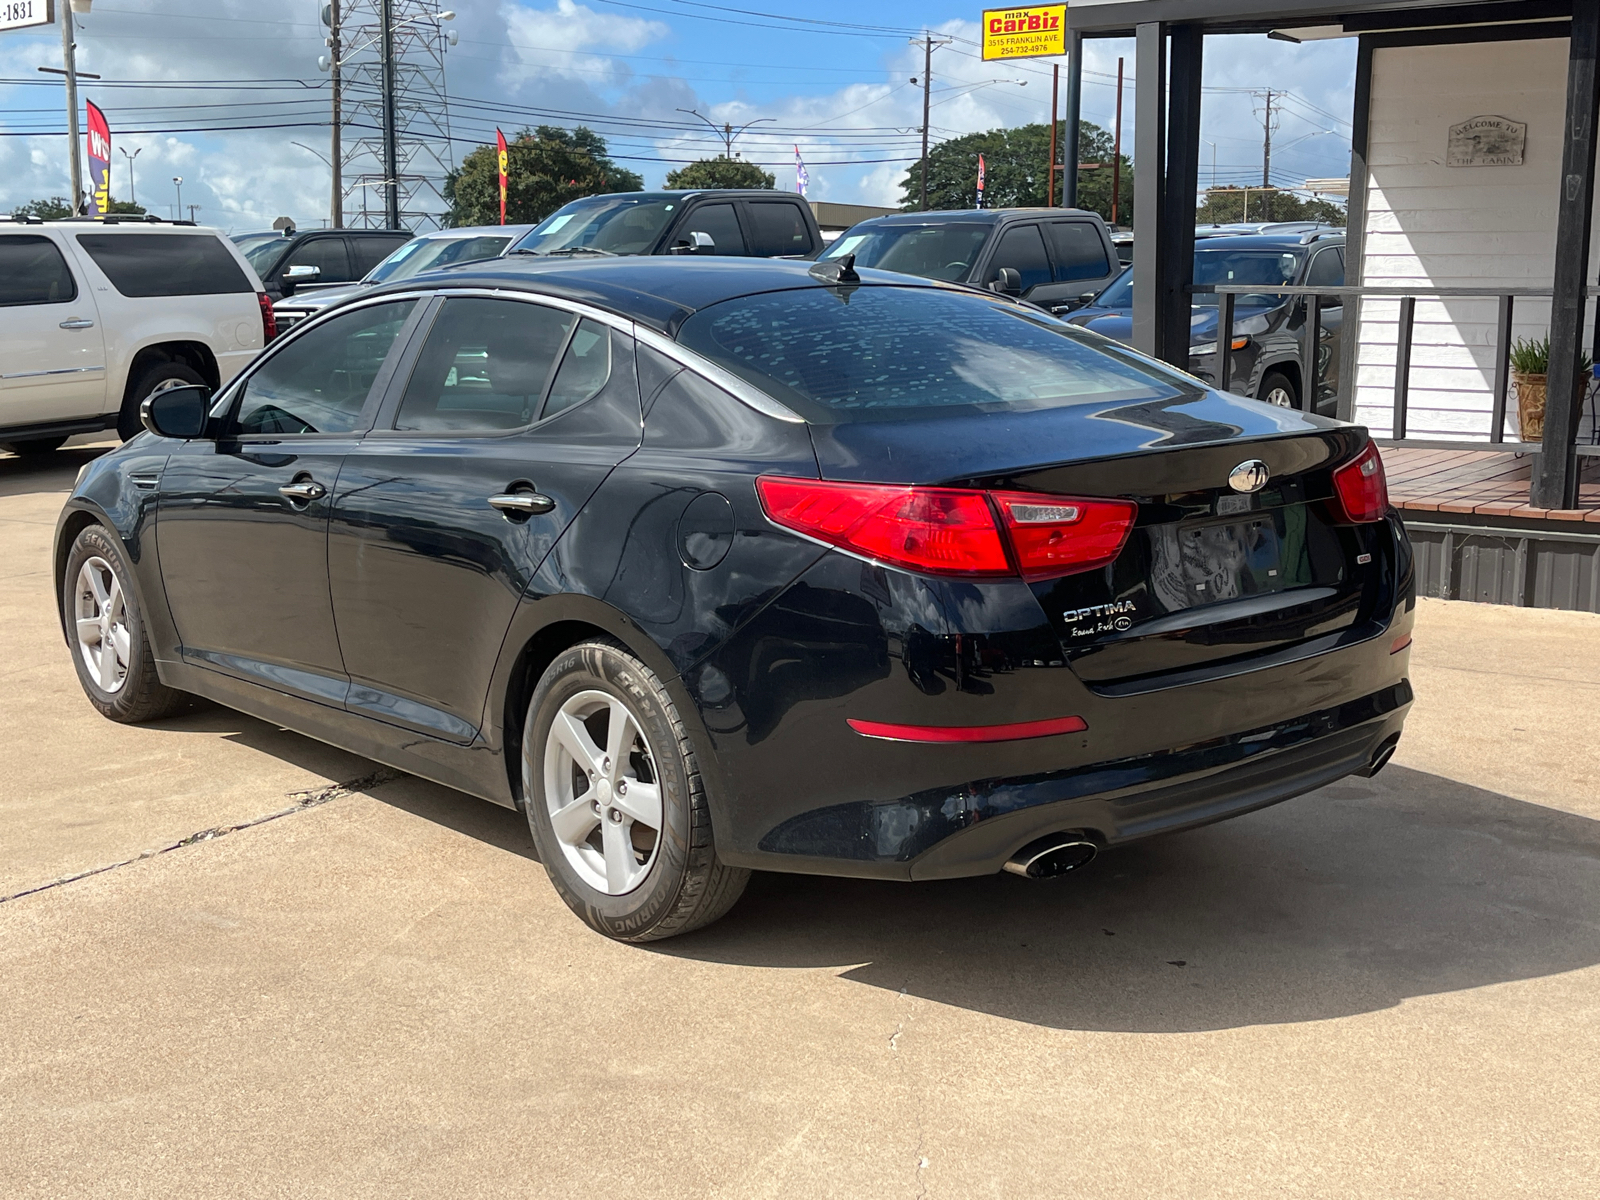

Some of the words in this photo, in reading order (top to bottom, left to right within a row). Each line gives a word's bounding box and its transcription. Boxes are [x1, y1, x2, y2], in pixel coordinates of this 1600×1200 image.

[0, 0, 33, 21] -1831
[1005, 11, 1030, 19] max
[990, 11, 1060, 33] CarBiz
[988, 39, 1005, 47] 3515
[1006, 35, 1042, 45] FRANKLIN
[1001, 44, 1048, 55] 254-732-4976
[1455, 120, 1502, 136] WELCOME
[1063, 600, 1136, 622] OPTIMA
